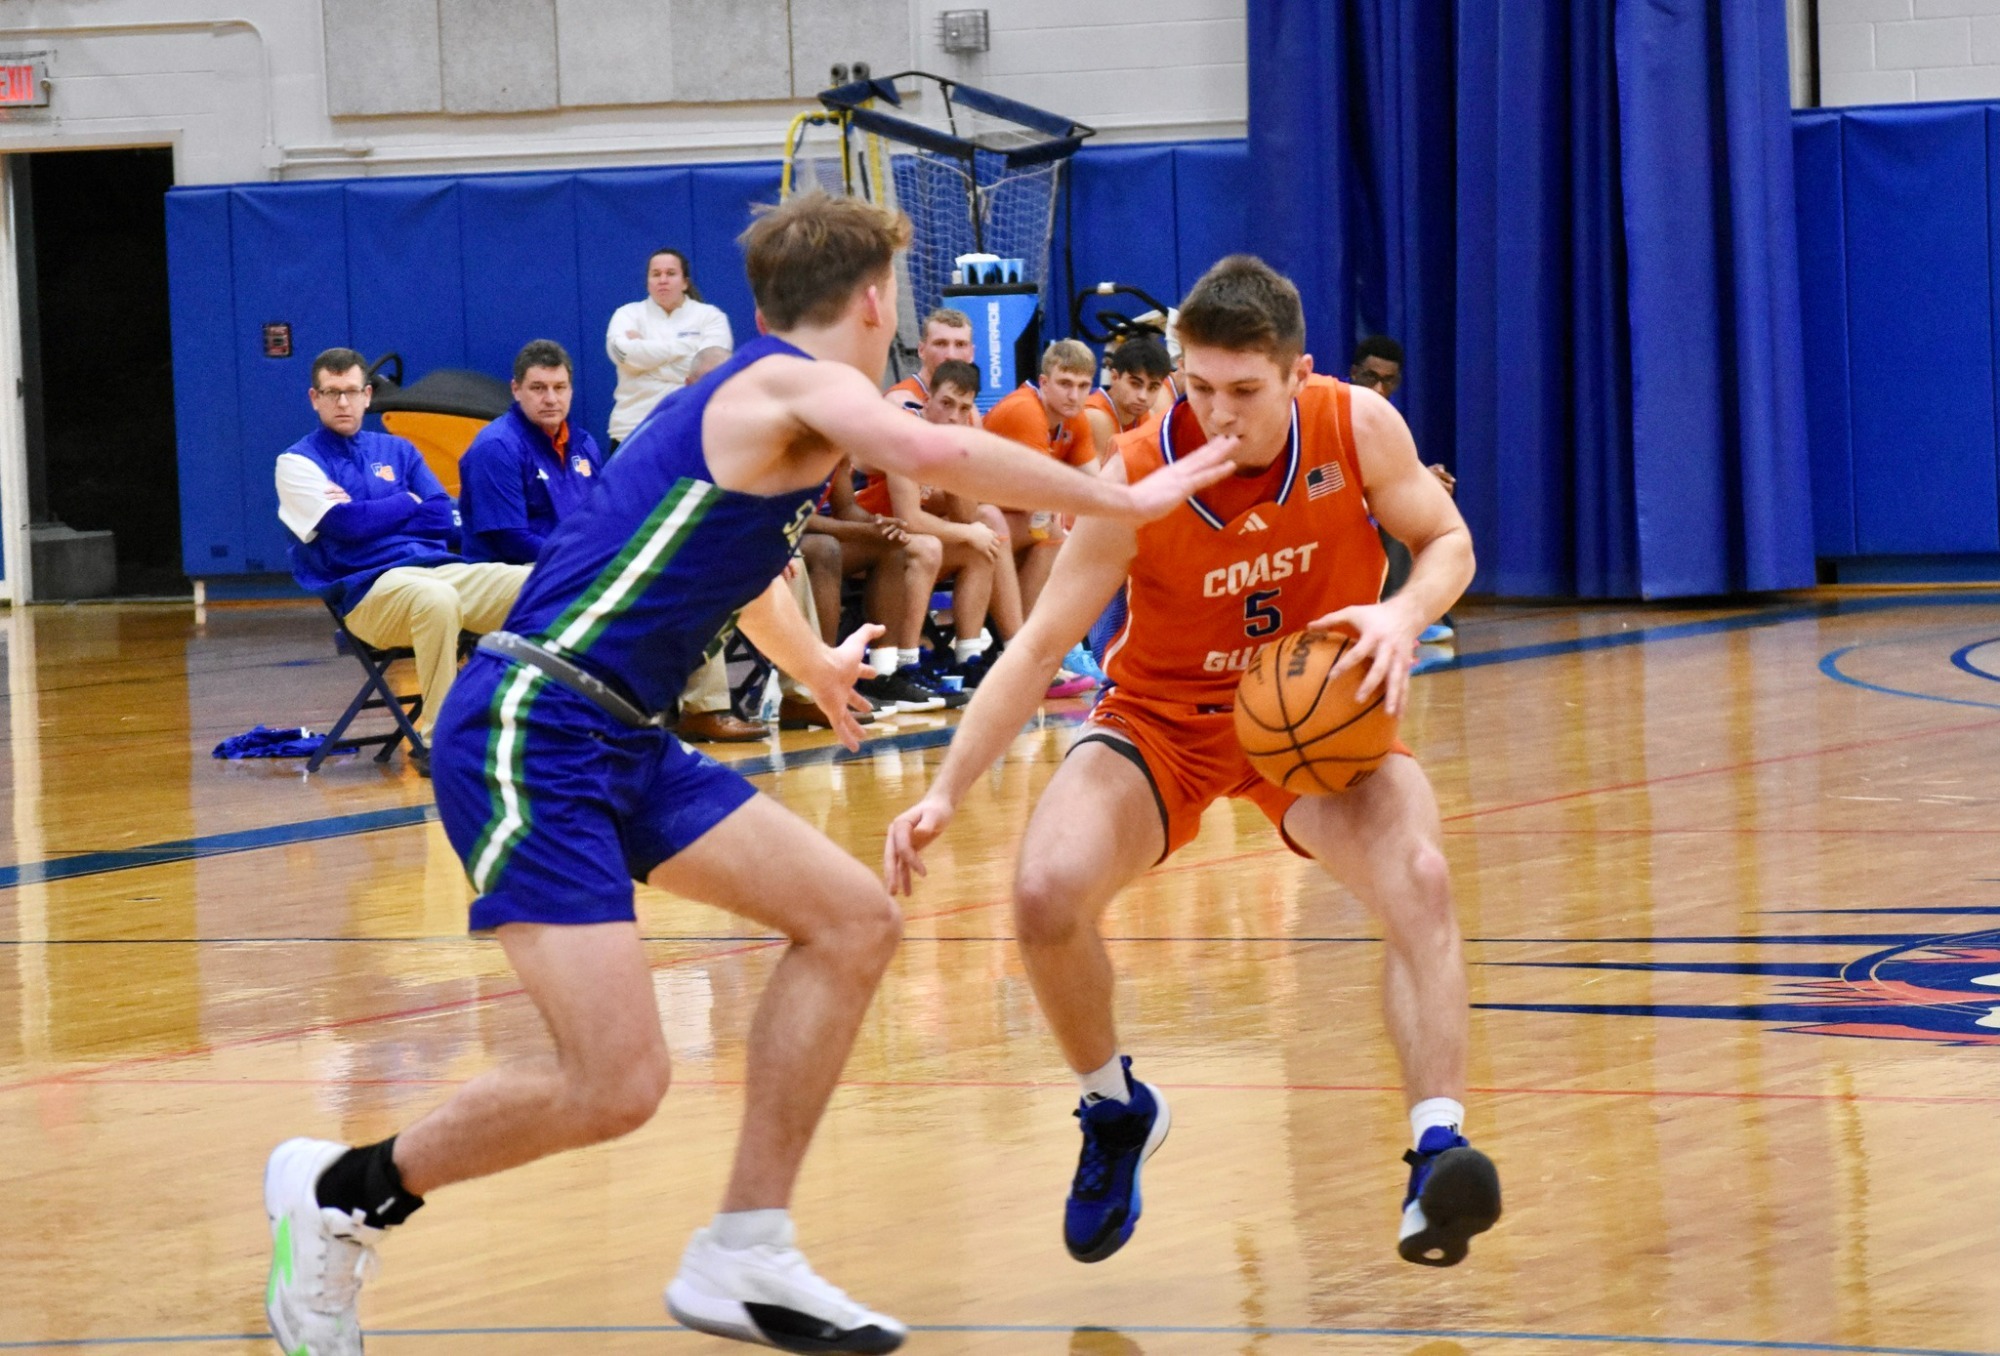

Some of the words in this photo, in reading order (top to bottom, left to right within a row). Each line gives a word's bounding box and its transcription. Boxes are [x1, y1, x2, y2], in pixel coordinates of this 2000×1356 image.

[987, 301, 1002, 389] POWERADE
[1203, 541, 1319, 598] COAST
[1244, 586, 1283, 638] 5
